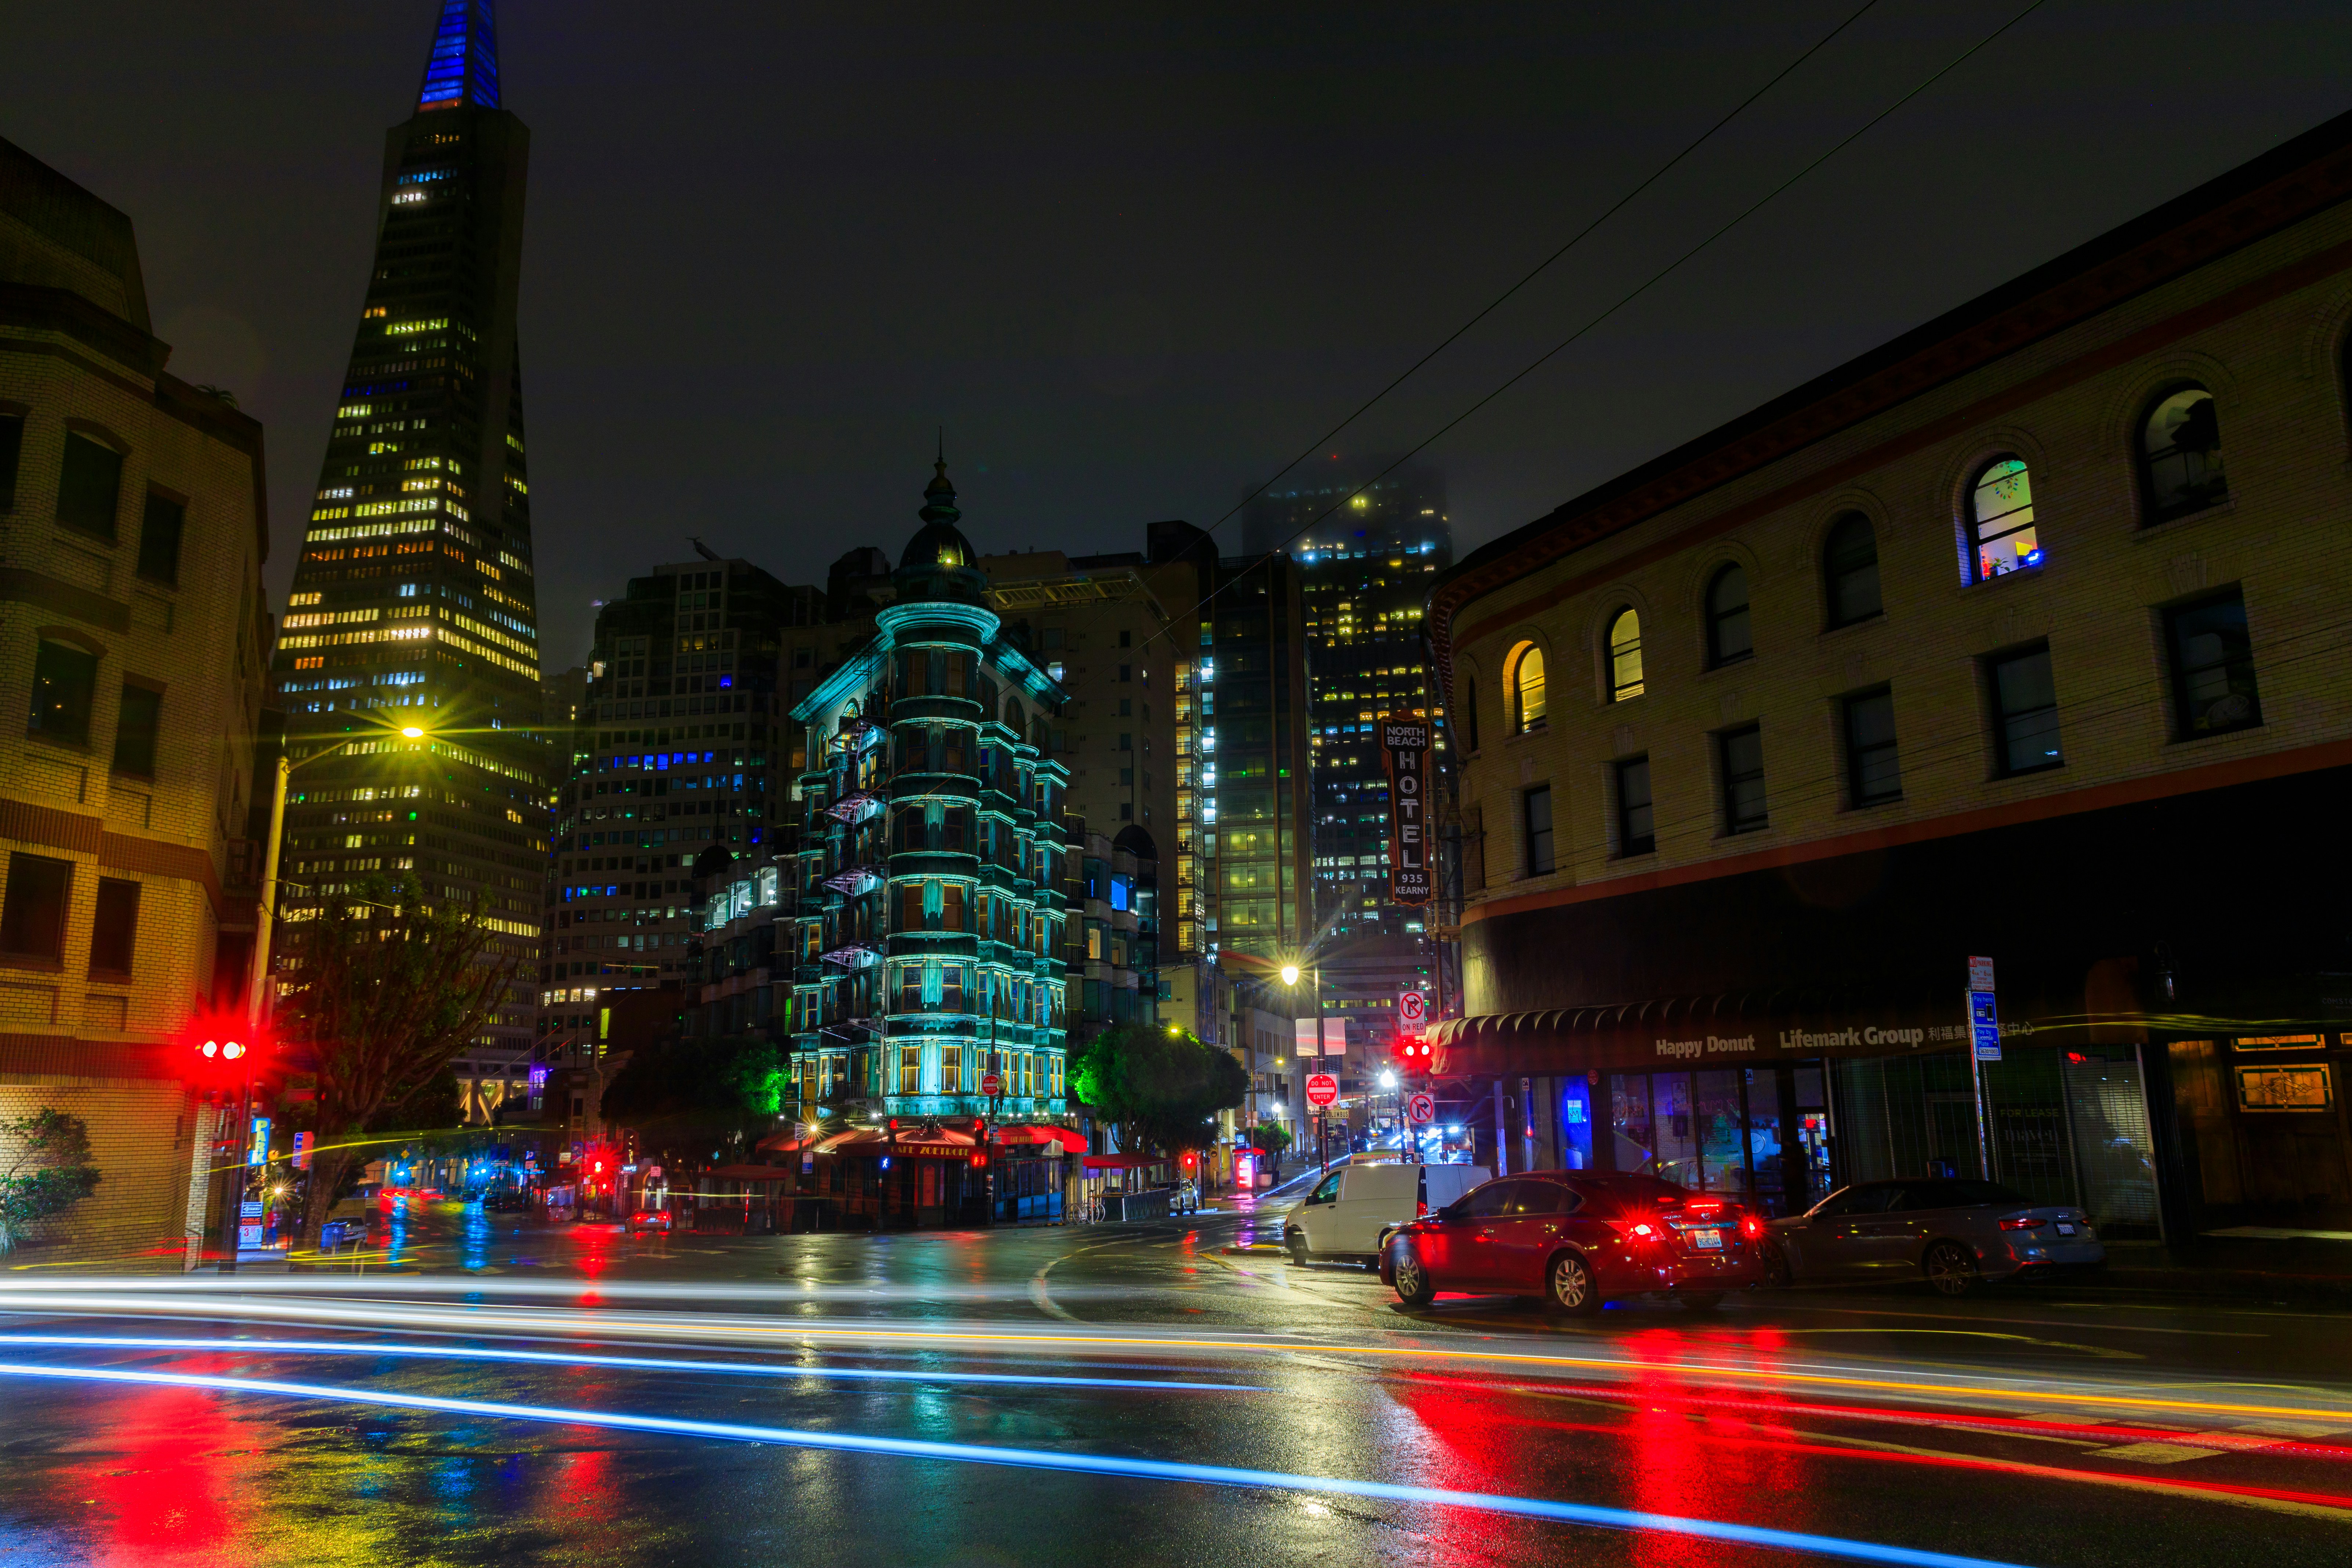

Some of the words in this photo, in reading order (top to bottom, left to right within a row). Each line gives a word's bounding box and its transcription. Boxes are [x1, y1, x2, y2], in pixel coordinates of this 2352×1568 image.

[1387, 726, 1425, 736] NORTH
[1387, 736, 1425, 747] BEACH
[1399, 751, 1421, 868] HOTEL
[1402, 874, 1423, 884] 935
[1395, 886, 1429, 895] KEARNY
[1969, 958, 1976, 966] NO
[1974, 996, 1982, 1004] Pay
[1779, 1027, 1861, 1049] Lifemark
[1864, 1027, 1924, 1047] Group
[1656, 1039, 1703, 1058] Happy
[1707, 1033, 1755, 1053] Donut
[2000, 1109, 2022, 1117] FOR
[2025, 1108, 2059, 1117] LEASE
[251, 1120, 268, 1164] PARK
[920, 1146, 970, 1156] ZOETROPE
[1698, 1237, 1720, 1245] 9GHC144
